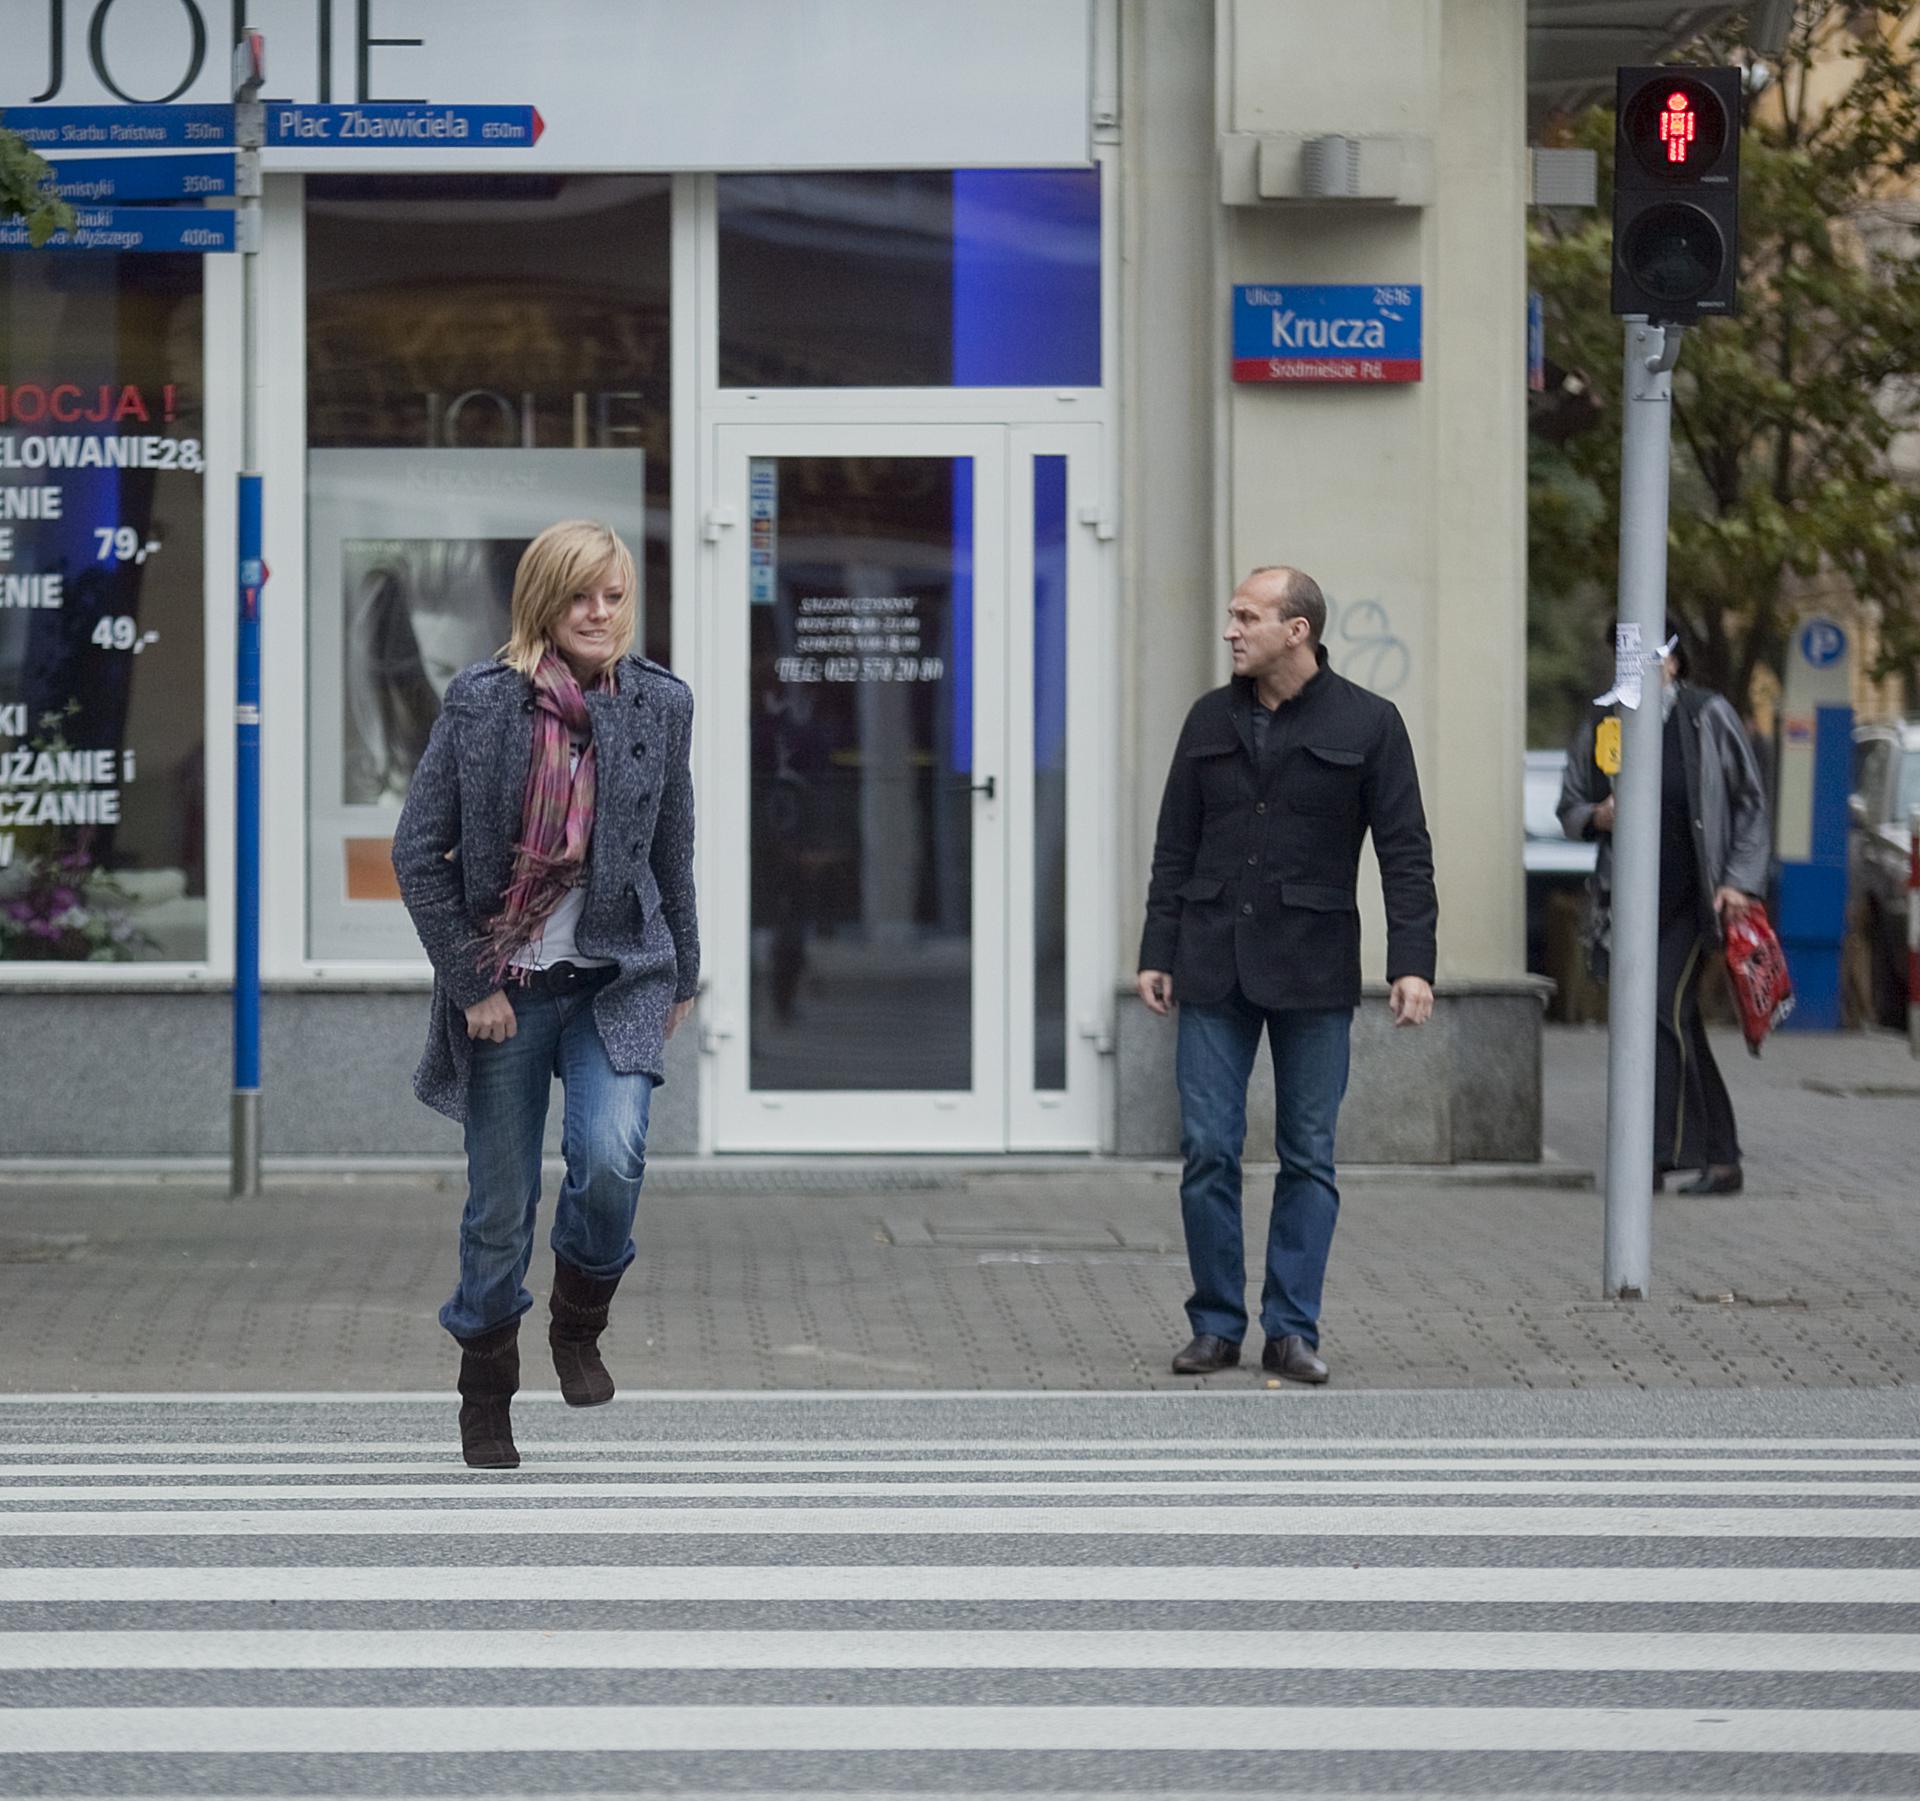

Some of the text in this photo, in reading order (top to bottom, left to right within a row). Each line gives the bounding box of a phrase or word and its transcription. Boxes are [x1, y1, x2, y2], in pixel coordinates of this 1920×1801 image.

[61, 124, 108, 141] Skarbu
[184, 123, 224, 140] 350m
[279, 111, 525, 138] Plac Zbawiciela 650m
[183, 176, 224, 193] 350m
[180, 229, 224, 246] 400m
[1271, 308, 1386, 348] Krucza
[0, 384, 149, 423] OCJA
